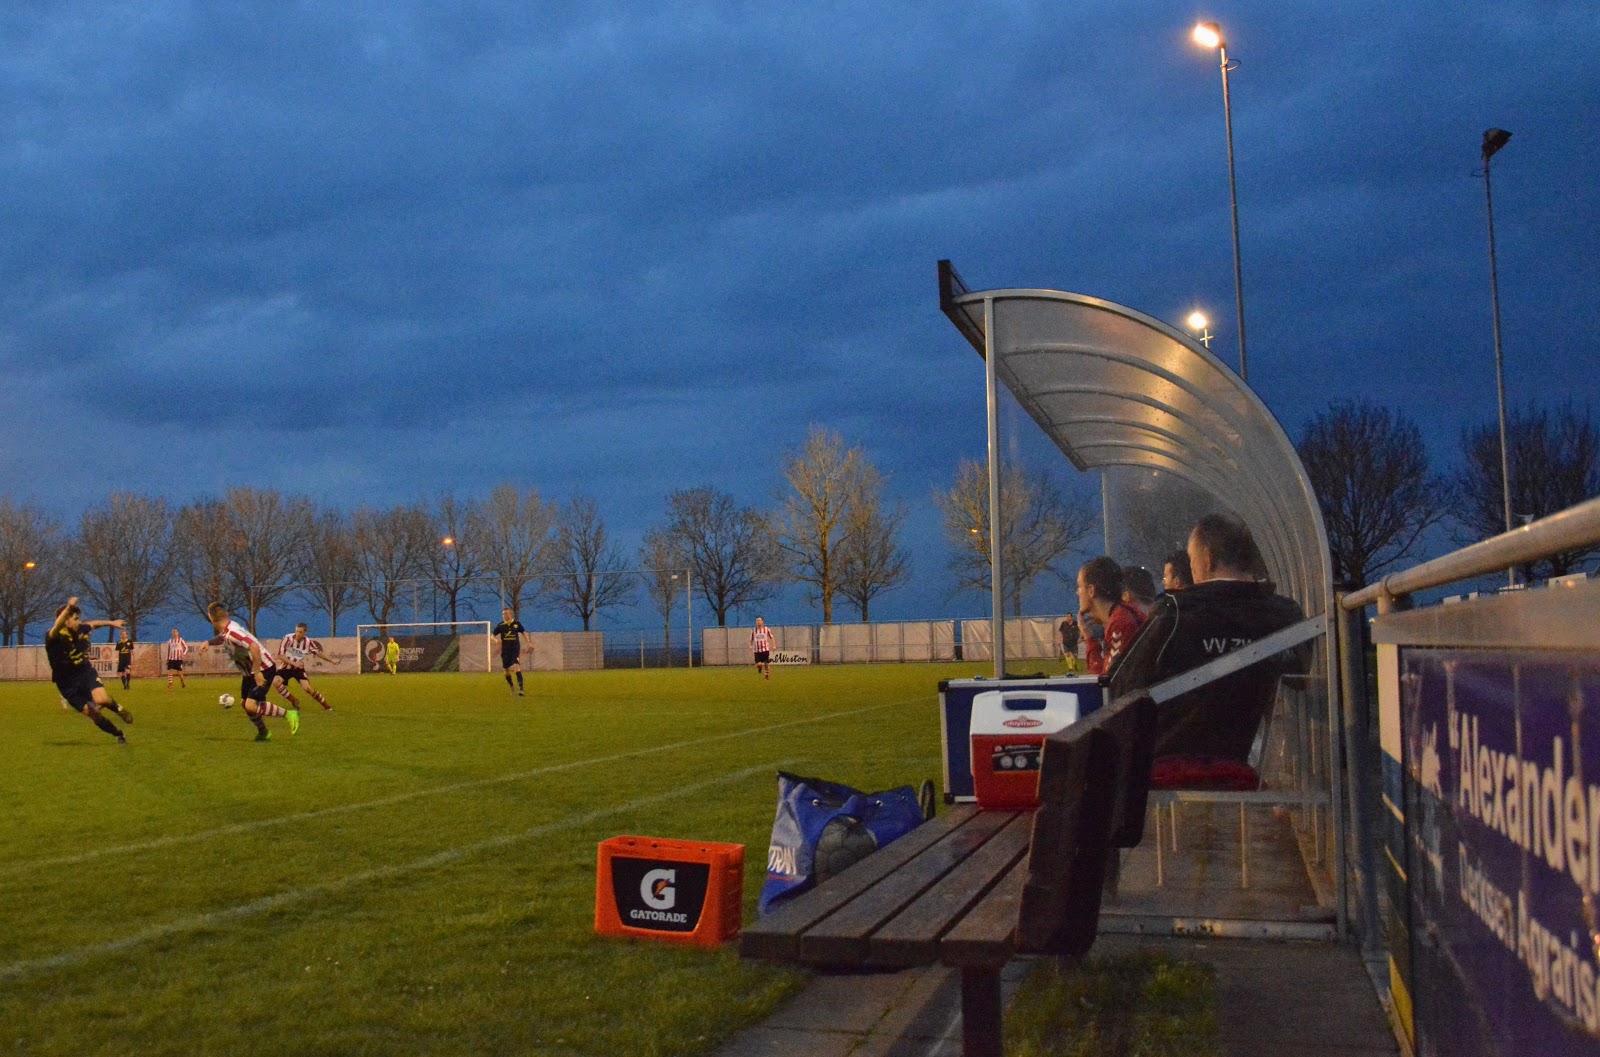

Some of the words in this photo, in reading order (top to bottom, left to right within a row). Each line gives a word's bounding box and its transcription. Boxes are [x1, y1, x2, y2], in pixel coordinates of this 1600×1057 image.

[400, 647, 425, 655] ENDARY
[1202, 637, 1226, 653] VV
[640, 868, 676, 910] G
[630, 909, 688, 923] GATORADE
